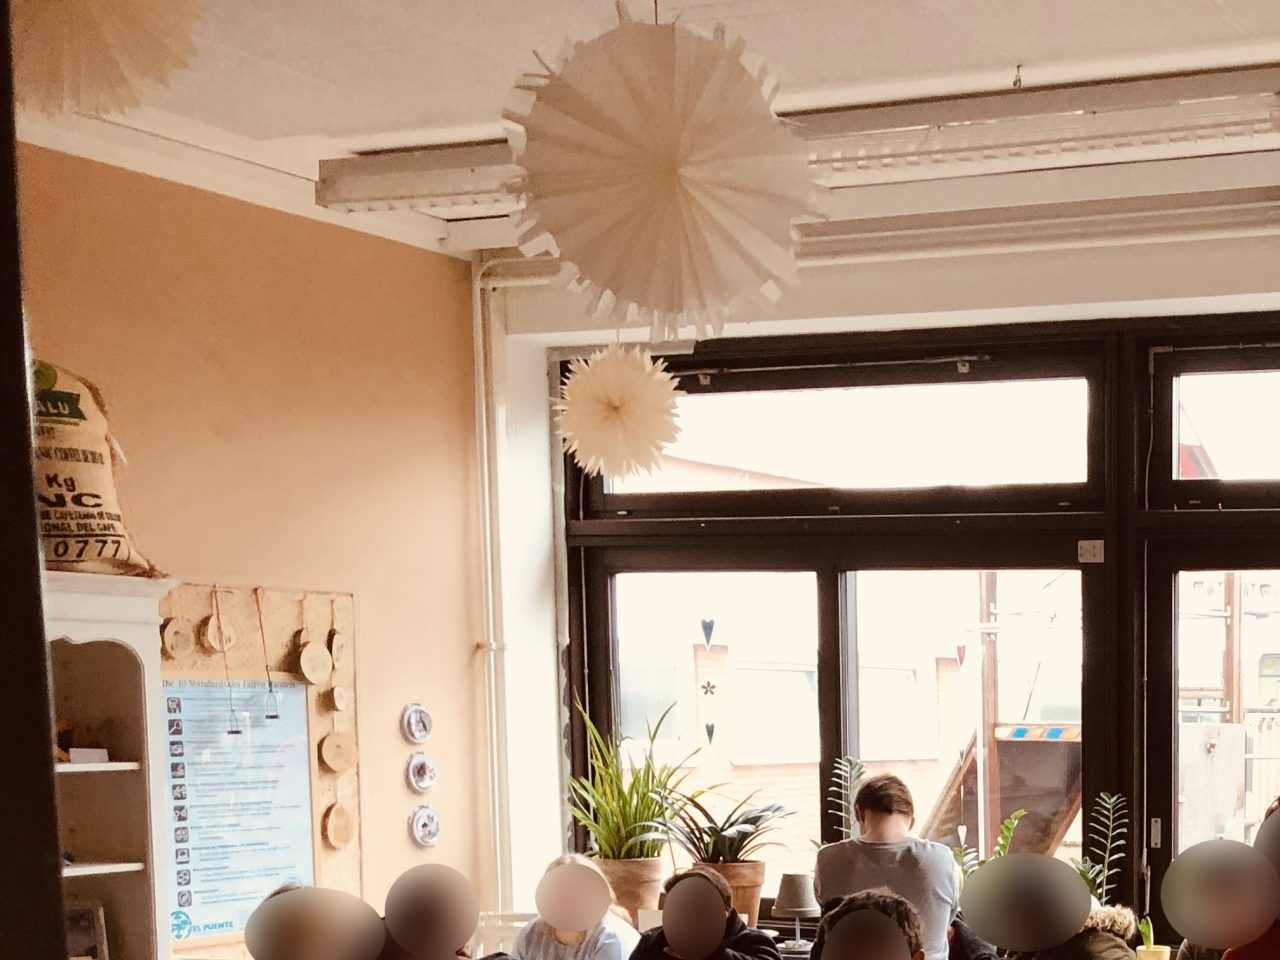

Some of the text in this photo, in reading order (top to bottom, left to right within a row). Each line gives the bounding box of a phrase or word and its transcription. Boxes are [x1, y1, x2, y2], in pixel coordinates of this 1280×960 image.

[45, 472, 77, 493] Kg
[53, 539, 122, 559] 0777
[203, 920, 235, 932] PUENTE
